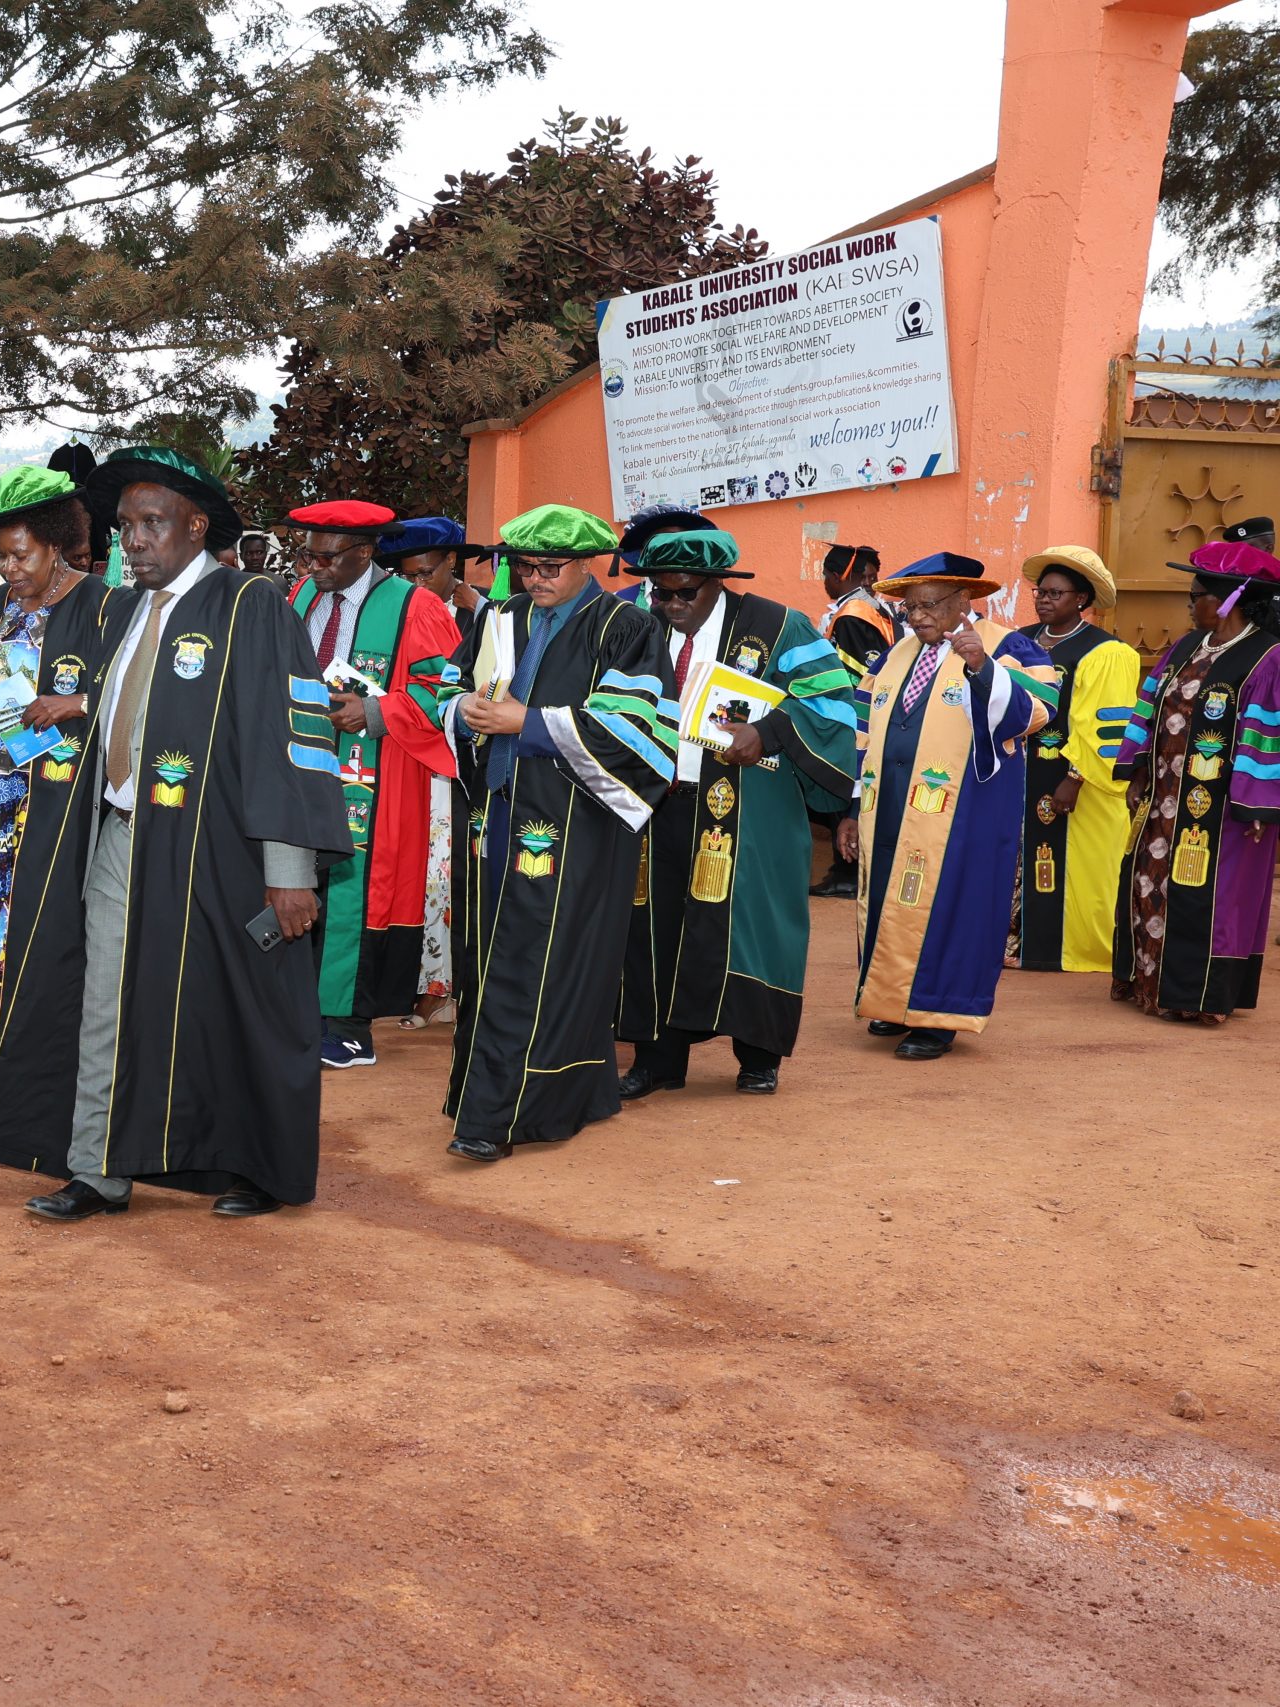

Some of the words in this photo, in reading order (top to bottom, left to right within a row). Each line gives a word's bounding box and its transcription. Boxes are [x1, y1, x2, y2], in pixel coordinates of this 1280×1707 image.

[643, 284, 694, 312] KABALE
[699, 260, 784, 298] UNIVERSITY
[788, 245, 844, 276] SOCIAL
[846, 231, 897, 261] WORK
[626, 307, 698, 339] STUDENTS'
[701, 282, 798, 322] ASSOCIATION
[664, 344, 709, 364] PROMOTE
[710, 337, 743, 354] SOCIAL
[743, 327, 787, 346] WELFARE
[788, 322, 811, 336] AND
[812, 304, 888, 331] DEVELOPMENT
[683, 329, 712, 346] WORK
[712, 318, 762, 339] TOGETHER
[763, 306, 812, 327] TOWARDS
[813, 296, 858, 316] ABETTER
[859, 285, 903, 306] SOCIETY
[633, 369, 667, 386] KABALE
[668, 357, 720, 378] UNIVERSITY
[720, 353, 743, 367] AND
[744, 349, 759, 362] ITS
[760, 332, 832, 358] ENVIRONMENT
[678, 373, 702, 388] work
[703, 365, 743, 383] together
[744, 356, 783, 374] towards
[784, 350, 819, 366] abetter
[820, 342, 856, 358] society
[625, 413, 655, 427] promote
[656, 410, 668, 420] the
[668, 405, 696, 417] welfare
[696, 400, 711, 412] and
[711, 391, 762, 408] development
[763, 387, 772, 398] of
[626, 427, 653, 438] advocate
[652, 422, 670, 434] social
[670, 419, 695, 430] workers
[695, 412, 730, 425] knowledge
[730, 407, 743, 419] and
[744, 404, 770, 418] practice
[770, 398, 798, 410] through
[872, 377, 913, 391] knowledge
[913, 371, 941, 384] sharing
[630, 442, 643, 453] link
[643, 438, 677, 450] members
[686, 433, 700, 442] the
[700, 425, 731, 439] national
[739, 415, 788, 432] international
[789, 411, 812, 423] social
[812, 407, 834, 418] work
[834, 400, 881, 415] association
[808, 416, 884, 448] welcomes
[884, 403, 939, 449] you!!
[622, 470, 647, 484] Email:
[623, 456, 652, 470] kabale
[653, 448, 700, 465] university:
